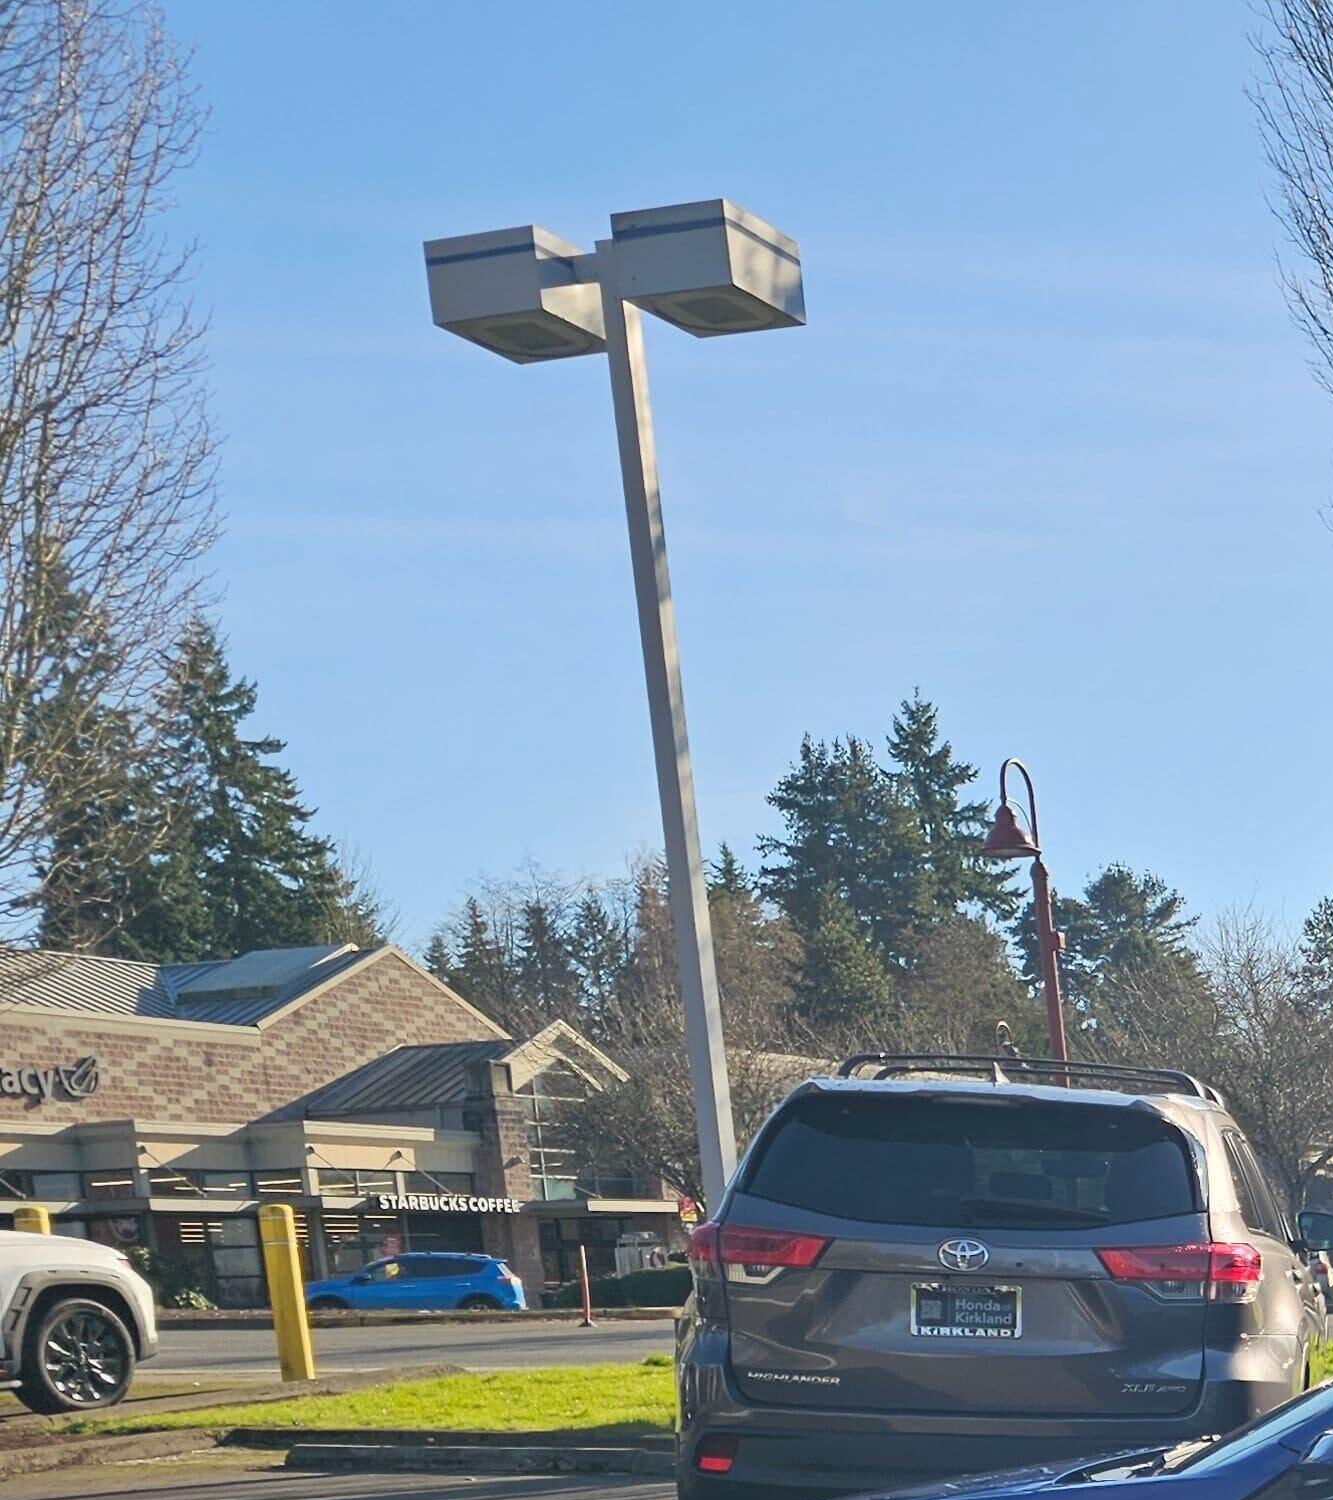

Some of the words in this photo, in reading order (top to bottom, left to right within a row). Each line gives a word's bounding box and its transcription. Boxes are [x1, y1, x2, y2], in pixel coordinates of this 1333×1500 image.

[378, 1194, 468, 1212] STARBUCKS
[469, 1197, 521, 1213] COFFEE
[955, 1298, 1001, 1311] Honda
[955, 1312, 1012, 1325] Kirkland
[920, 1327, 1012, 1337] KIRKLAND
[747, 1371, 840, 1385] HIGHLANDER
